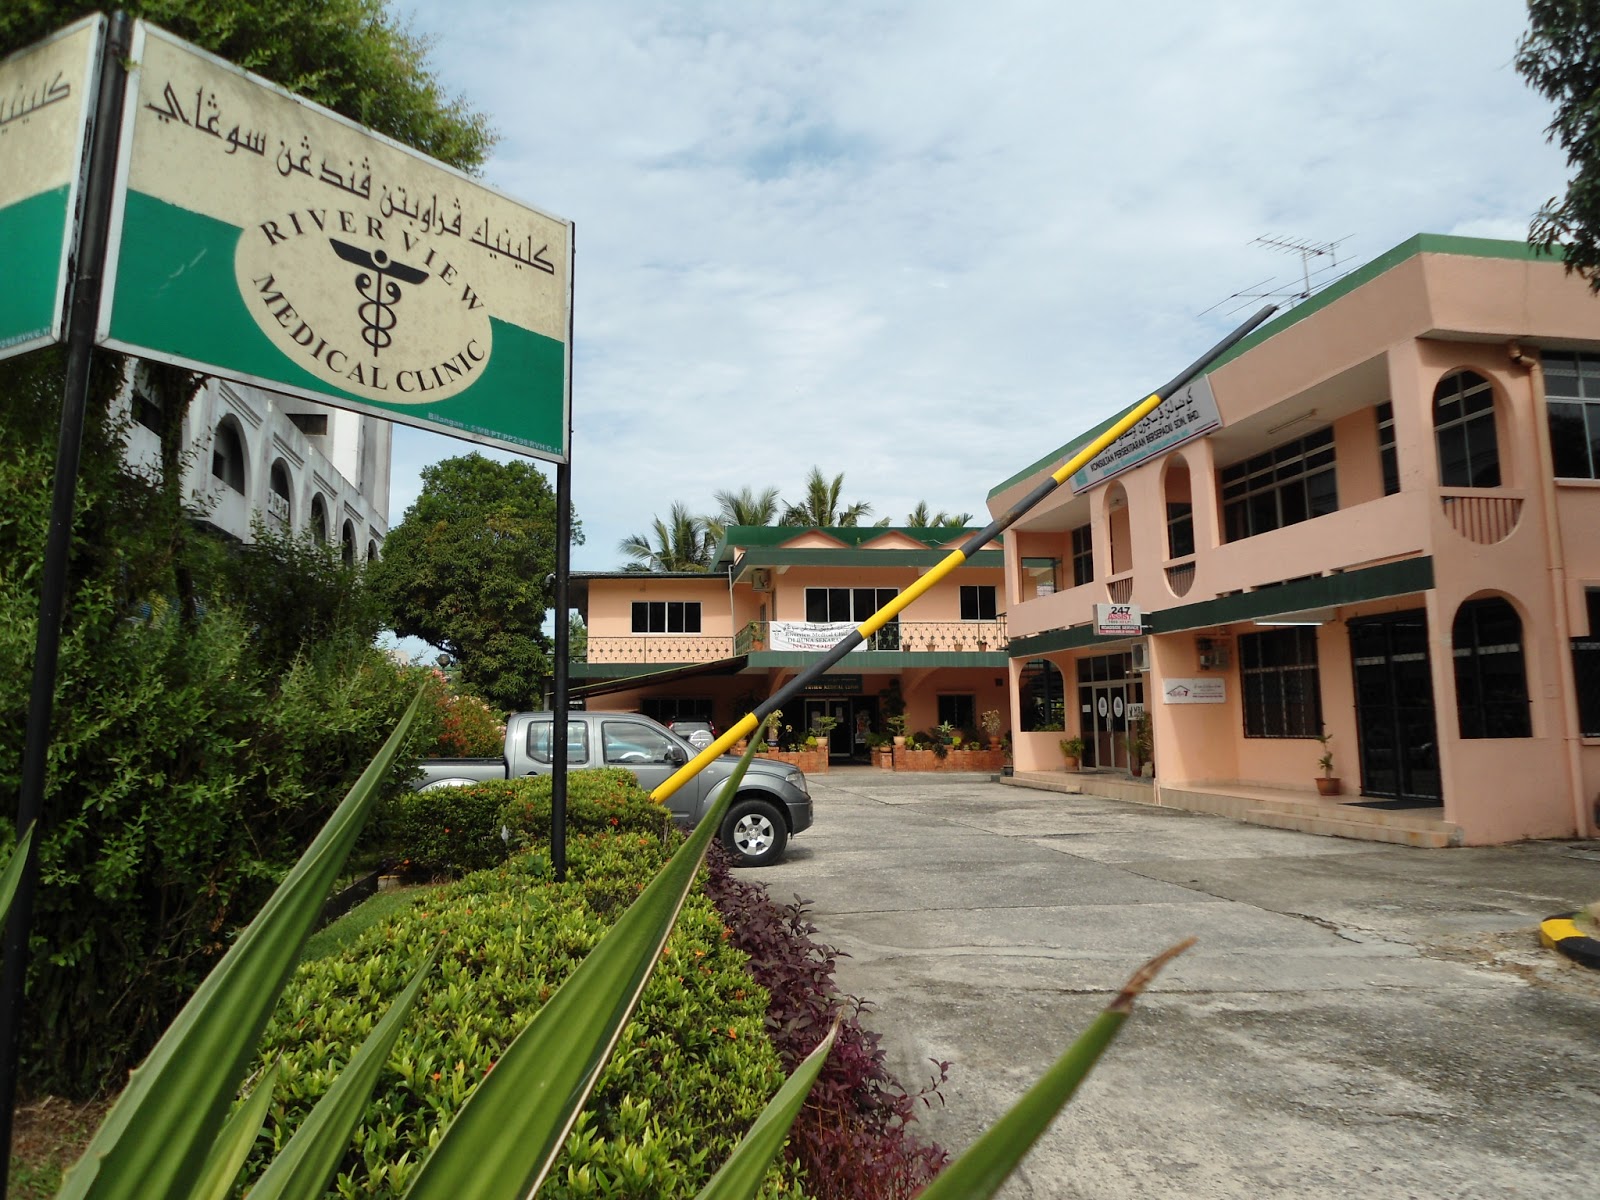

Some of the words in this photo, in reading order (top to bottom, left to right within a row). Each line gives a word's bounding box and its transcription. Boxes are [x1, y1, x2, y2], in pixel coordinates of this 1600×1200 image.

[259, 208, 386, 247] RIVER
[401, 231, 485, 312] VIEW
[468, 217, 555, 276] كلينيك
[252, 273, 388, 391] MEDICAL
[395, 339, 486, 393] CLINIC
[428, 412, 464, 429] Bilangan
[1090, 454, 1115, 472] KONSULTAN
[1114, 439, 1146, 459] PERSEKITARAN
[1146, 424, 1174, 444] BERSEPADU
[1111, 606, 1131, 614] 247
